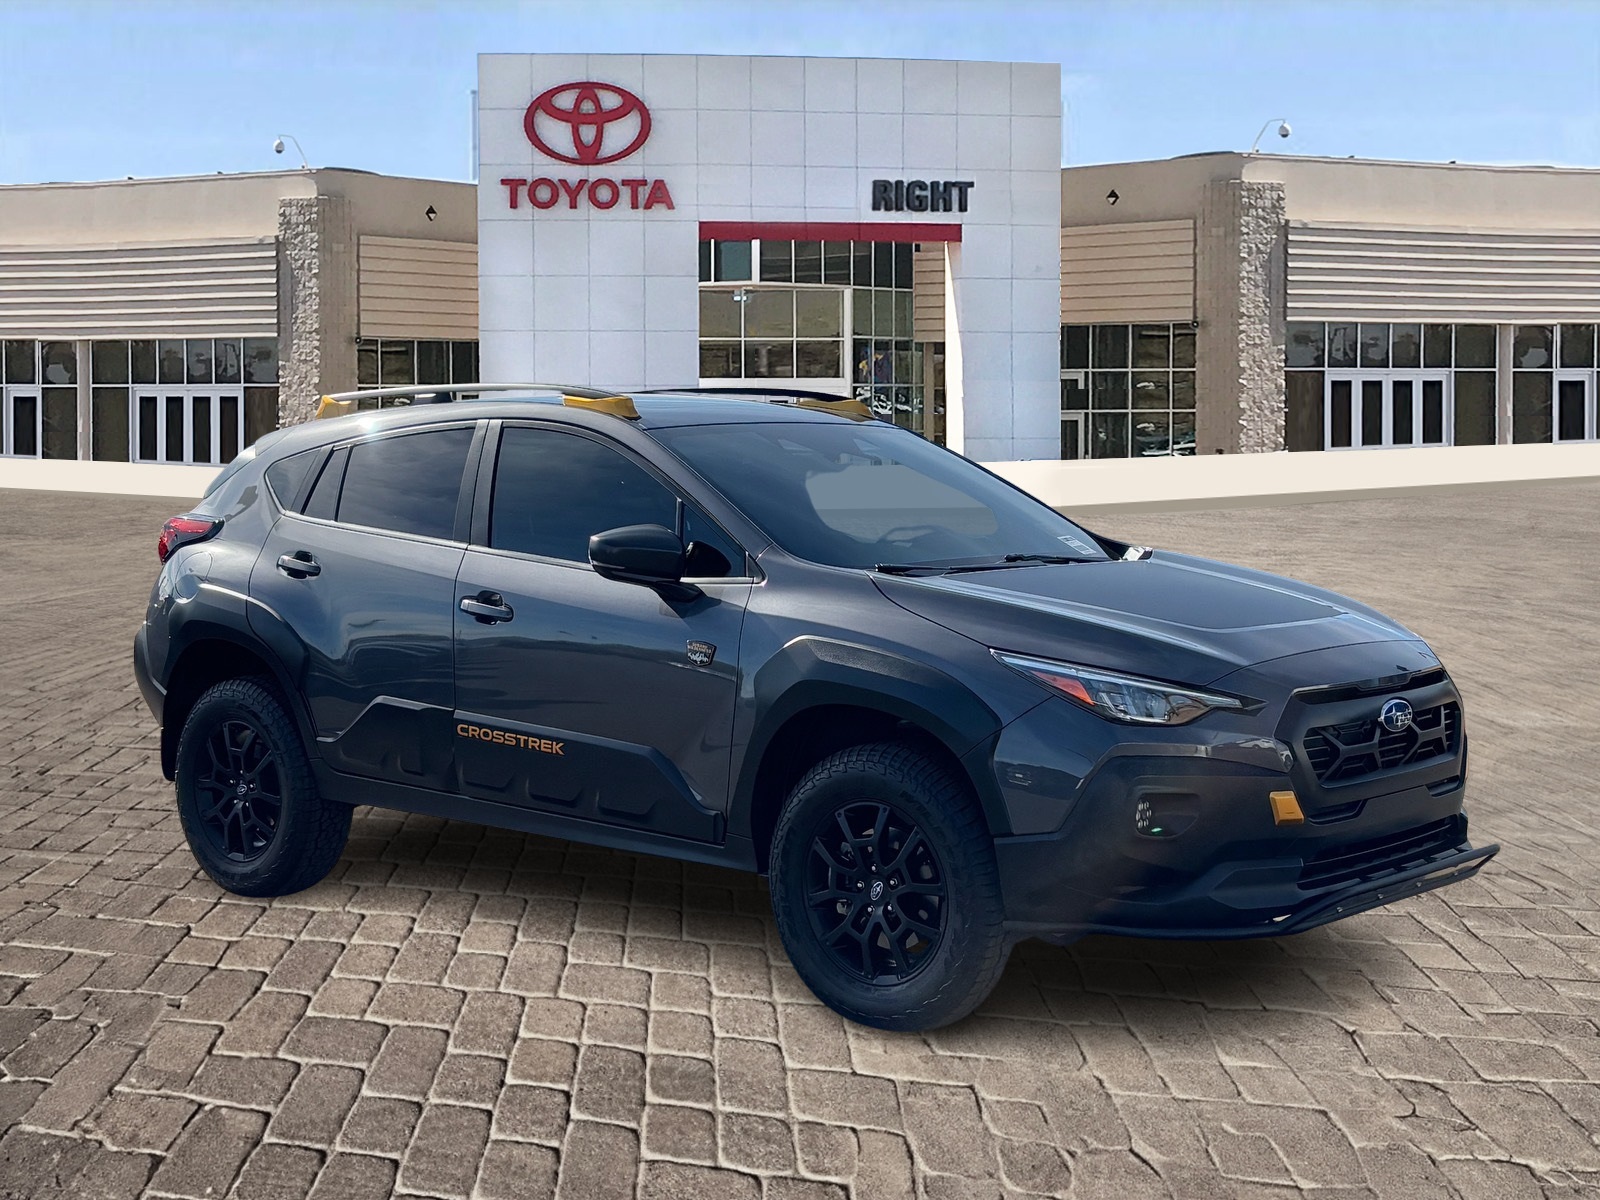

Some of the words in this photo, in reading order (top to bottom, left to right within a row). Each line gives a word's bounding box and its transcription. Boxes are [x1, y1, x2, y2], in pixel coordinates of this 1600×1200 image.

[500, 178, 675, 209] TOYOTA
[872, 180, 975, 212] RIGHT
[456, 724, 565, 755] CROSSTREK
